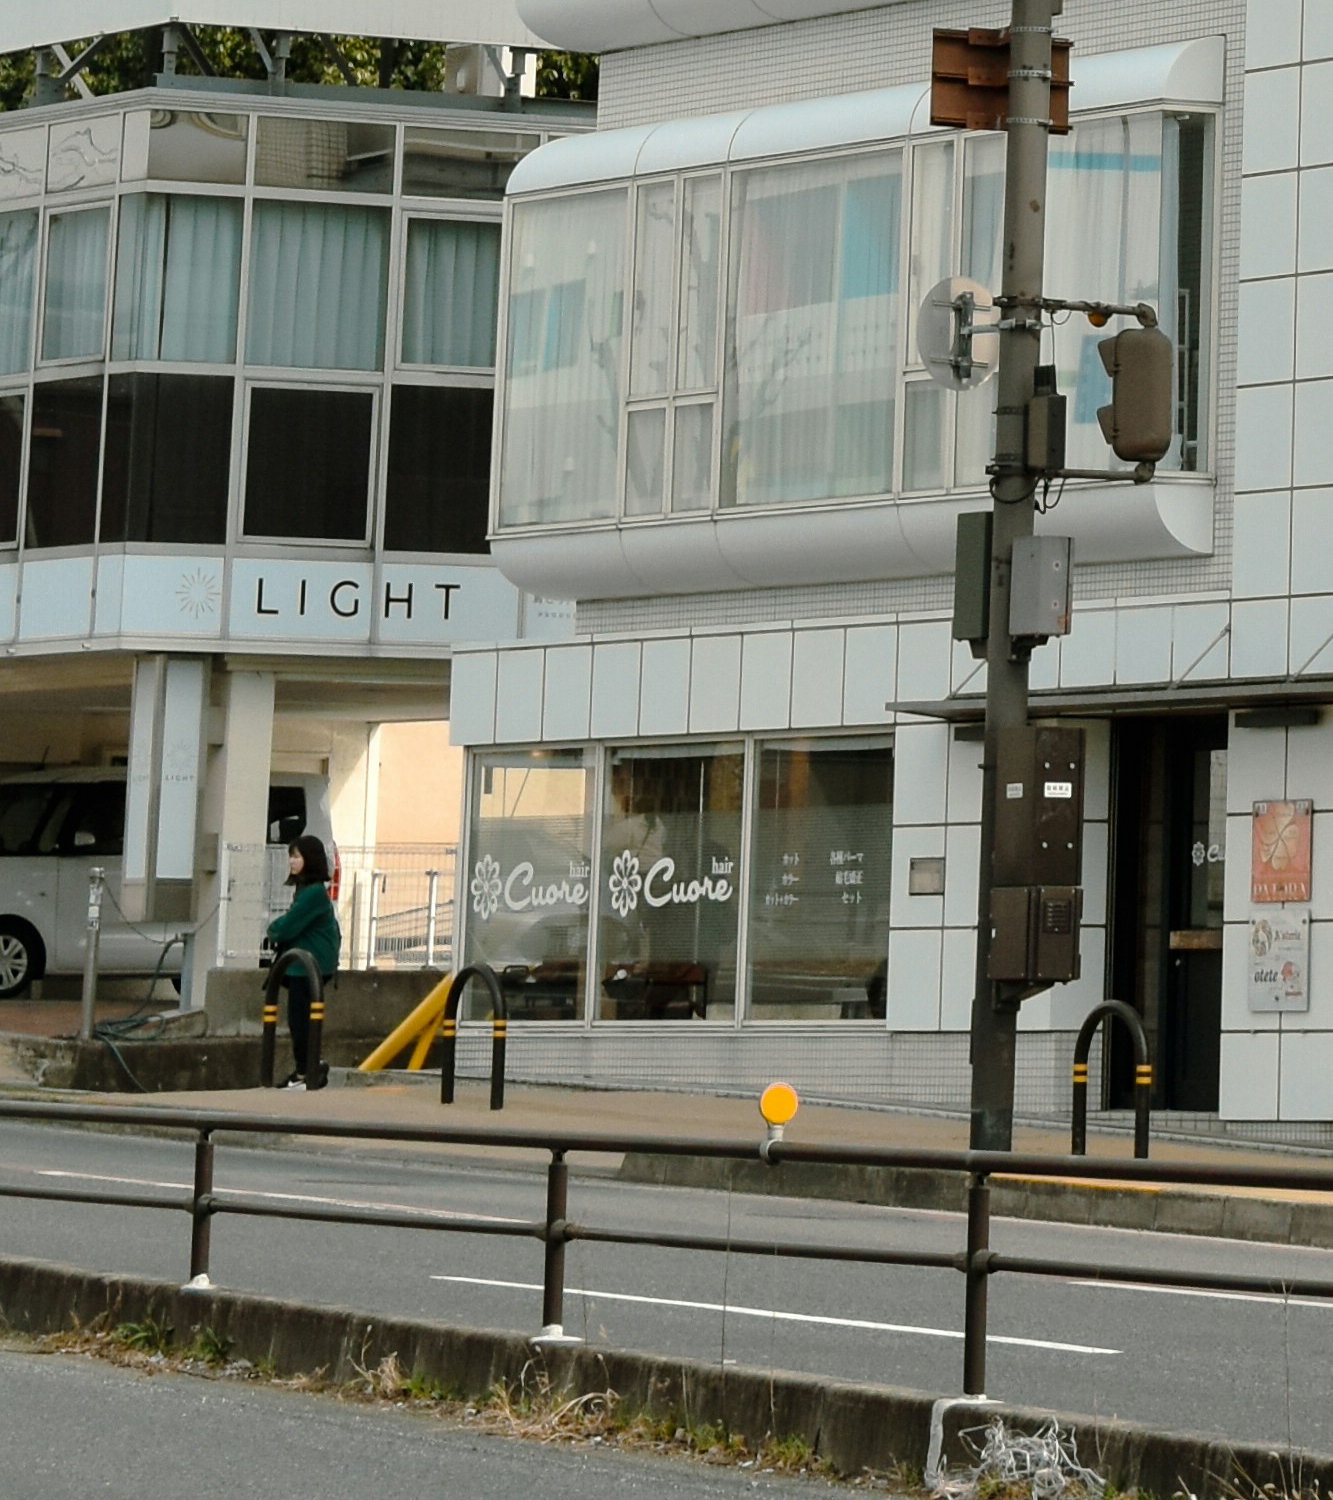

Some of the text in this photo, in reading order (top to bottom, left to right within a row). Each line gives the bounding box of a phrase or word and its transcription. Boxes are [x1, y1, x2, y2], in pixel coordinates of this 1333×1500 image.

[256, 578, 461, 620] LIGHT
[504, 861, 589, 910] Cuore
[569, 860, 590, 879] hair
[644, 857, 733, 908] Cuore
[712, 856, 735, 875] hair
